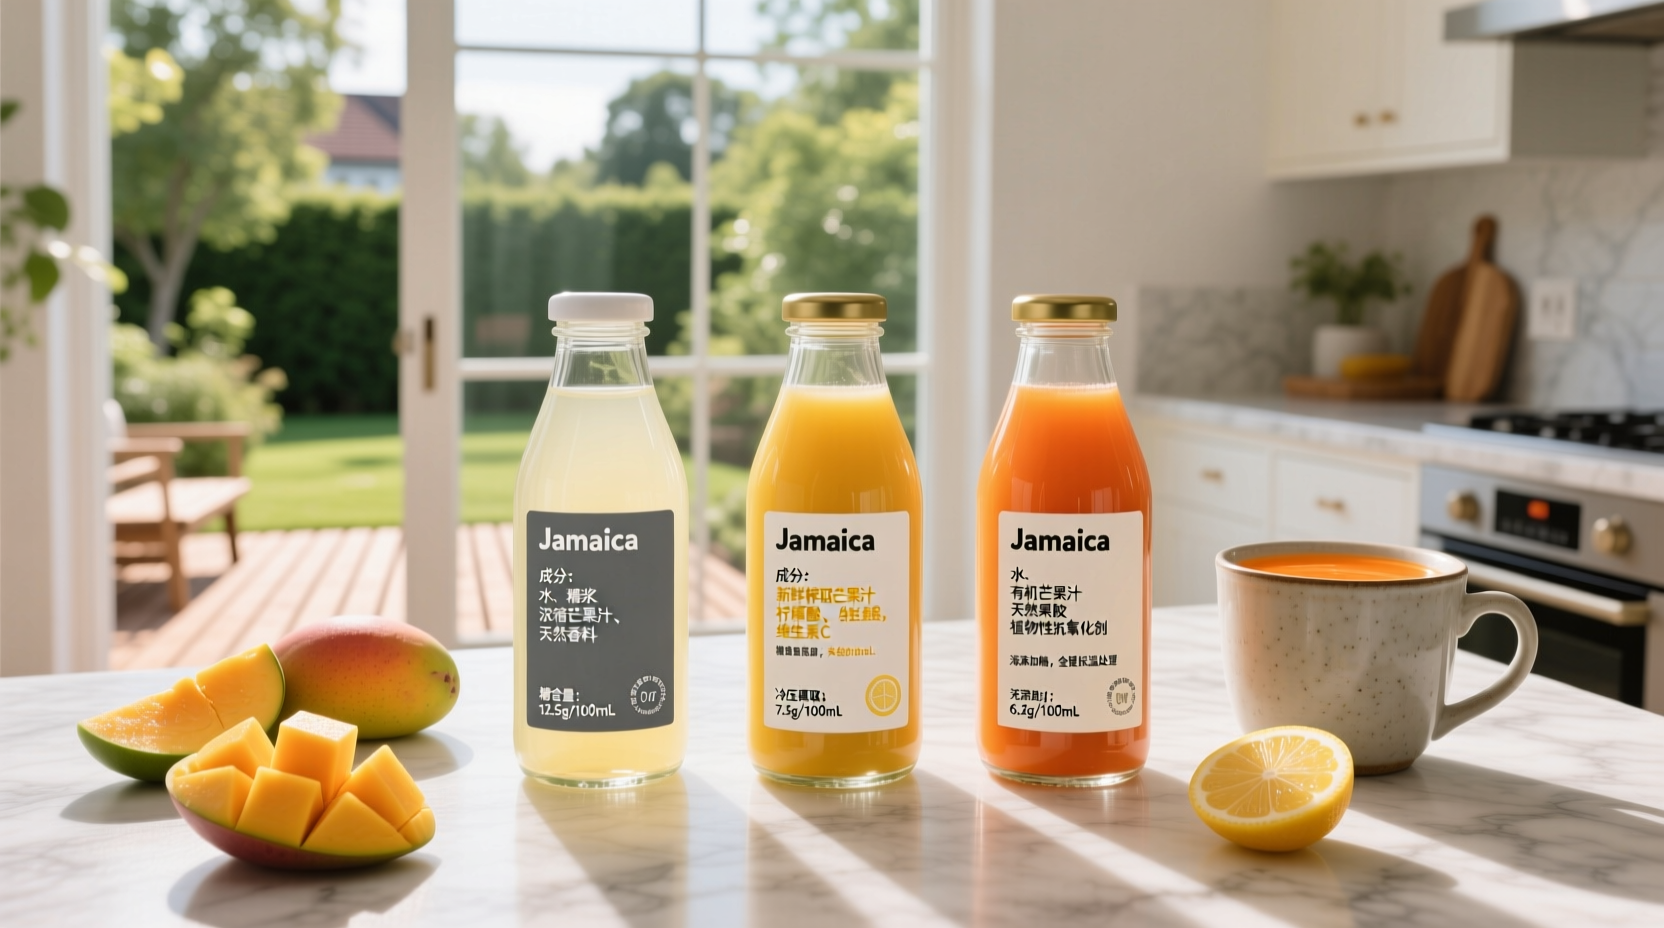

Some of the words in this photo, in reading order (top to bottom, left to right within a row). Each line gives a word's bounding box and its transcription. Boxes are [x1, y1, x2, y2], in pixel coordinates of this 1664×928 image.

[539, 527, 638, 551] Jamaica
[776, 527, 875, 552] Jamaica
[1010, 527, 1110, 552] Jamaica
[1010, 585, 1082, 602] 有机芒果汁
[539, 703, 616, 720] 12.5g/100mL
[775, 703, 842, 720] 7.5g/100mL
